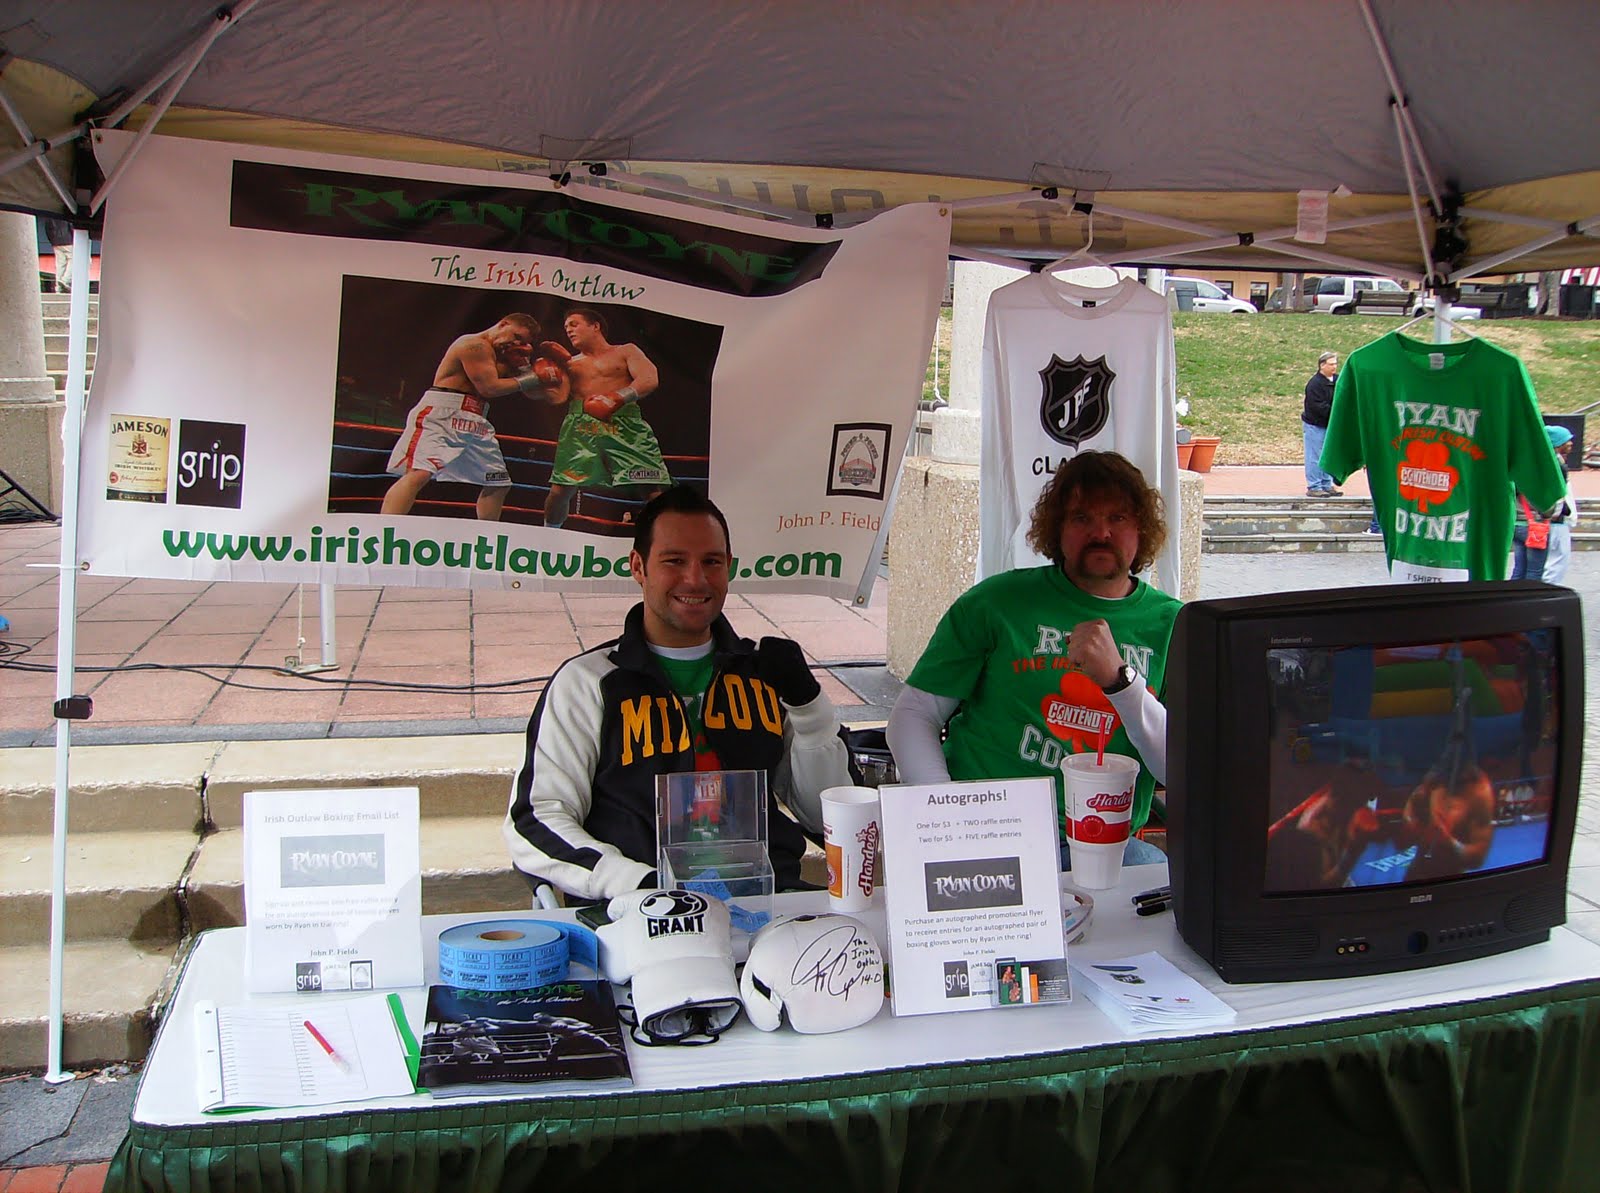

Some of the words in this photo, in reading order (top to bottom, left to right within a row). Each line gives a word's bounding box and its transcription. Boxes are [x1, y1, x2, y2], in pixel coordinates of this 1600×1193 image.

[430, 256, 477, 283] The
[484, 261, 545, 288] Irish
[551, 269, 646, 300] Outlaw
[1058, 376, 1092, 428] JPF
[111, 420, 168, 438] JAMESON
[179, 441, 241, 491] grip
[1400, 468, 1450, 488] CONTENDER
[776, 513, 814, 533] John
[819, 510, 835, 526] P.
[162, 525, 842, 579] www.irishoutlawbo.com
[1033, 624, 1153, 678] RN
[1012, 656, 1047, 674] THE
[927, 789, 1008, 806] Autographs!
[264, 815, 285, 823] Irish
[287, 814, 321, 823] Outlaw
[323, 813, 354, 823] Boxing
[356, 812, 382, 821] Email
[384, 811, 400, 820] List
[916, 822, 930, 830] One
[931, 821, 941, 829] for
[943, 821, 951, 829] $3
[964, 819, 980, 827] TWO
[980, 818, 998, 826] raffle
[999, 817, 1022, 825] entries
[918, 836, 933, 844] Two
[934, 835, 944, 843] for
[945, 835, 953, 843] $5
[965, 833, 980, 841] FIVE
[980, 832, 998, 840] raffle
[999, 831, 1022, 839] entries
[933, 875, 971, 898] RYAN
[971, 874, 1016, 894] COYNE
[1410, 894, 1432, 903] RCA
[284, 921, 292, 930] by
[647, 913, 705, 939] GRANT
[904, 917, 935, 926] Purchase
[945, 914, 987, 924] autographed
[988, 911, 1028, 921] promotional
[1029, 909, 1044, 918] flyer
[939, 927, 962, 935] entries
[963, 925, 973, 933] for
[984, 922, 1025, 932] autographed
[1026, 920, 1039, 929] pair
[1040, 919, 1047, 927] of
[852, 938, 868, 947] The
[906, 940, 928, 949] boxing
[929, 939, 951, 948] gloves
[970, 936, 978, 946] by
[979, 935, 996, 944] Ryan
[1016, 932, 1032, 942] ring!
[310, 949, 327, 957] John
[337, 948, 359, 956] Fields
[851, 948, 875, 960] Irish
[297, 968, 321, 990] grip
[945, 968, 968, 991] grip
